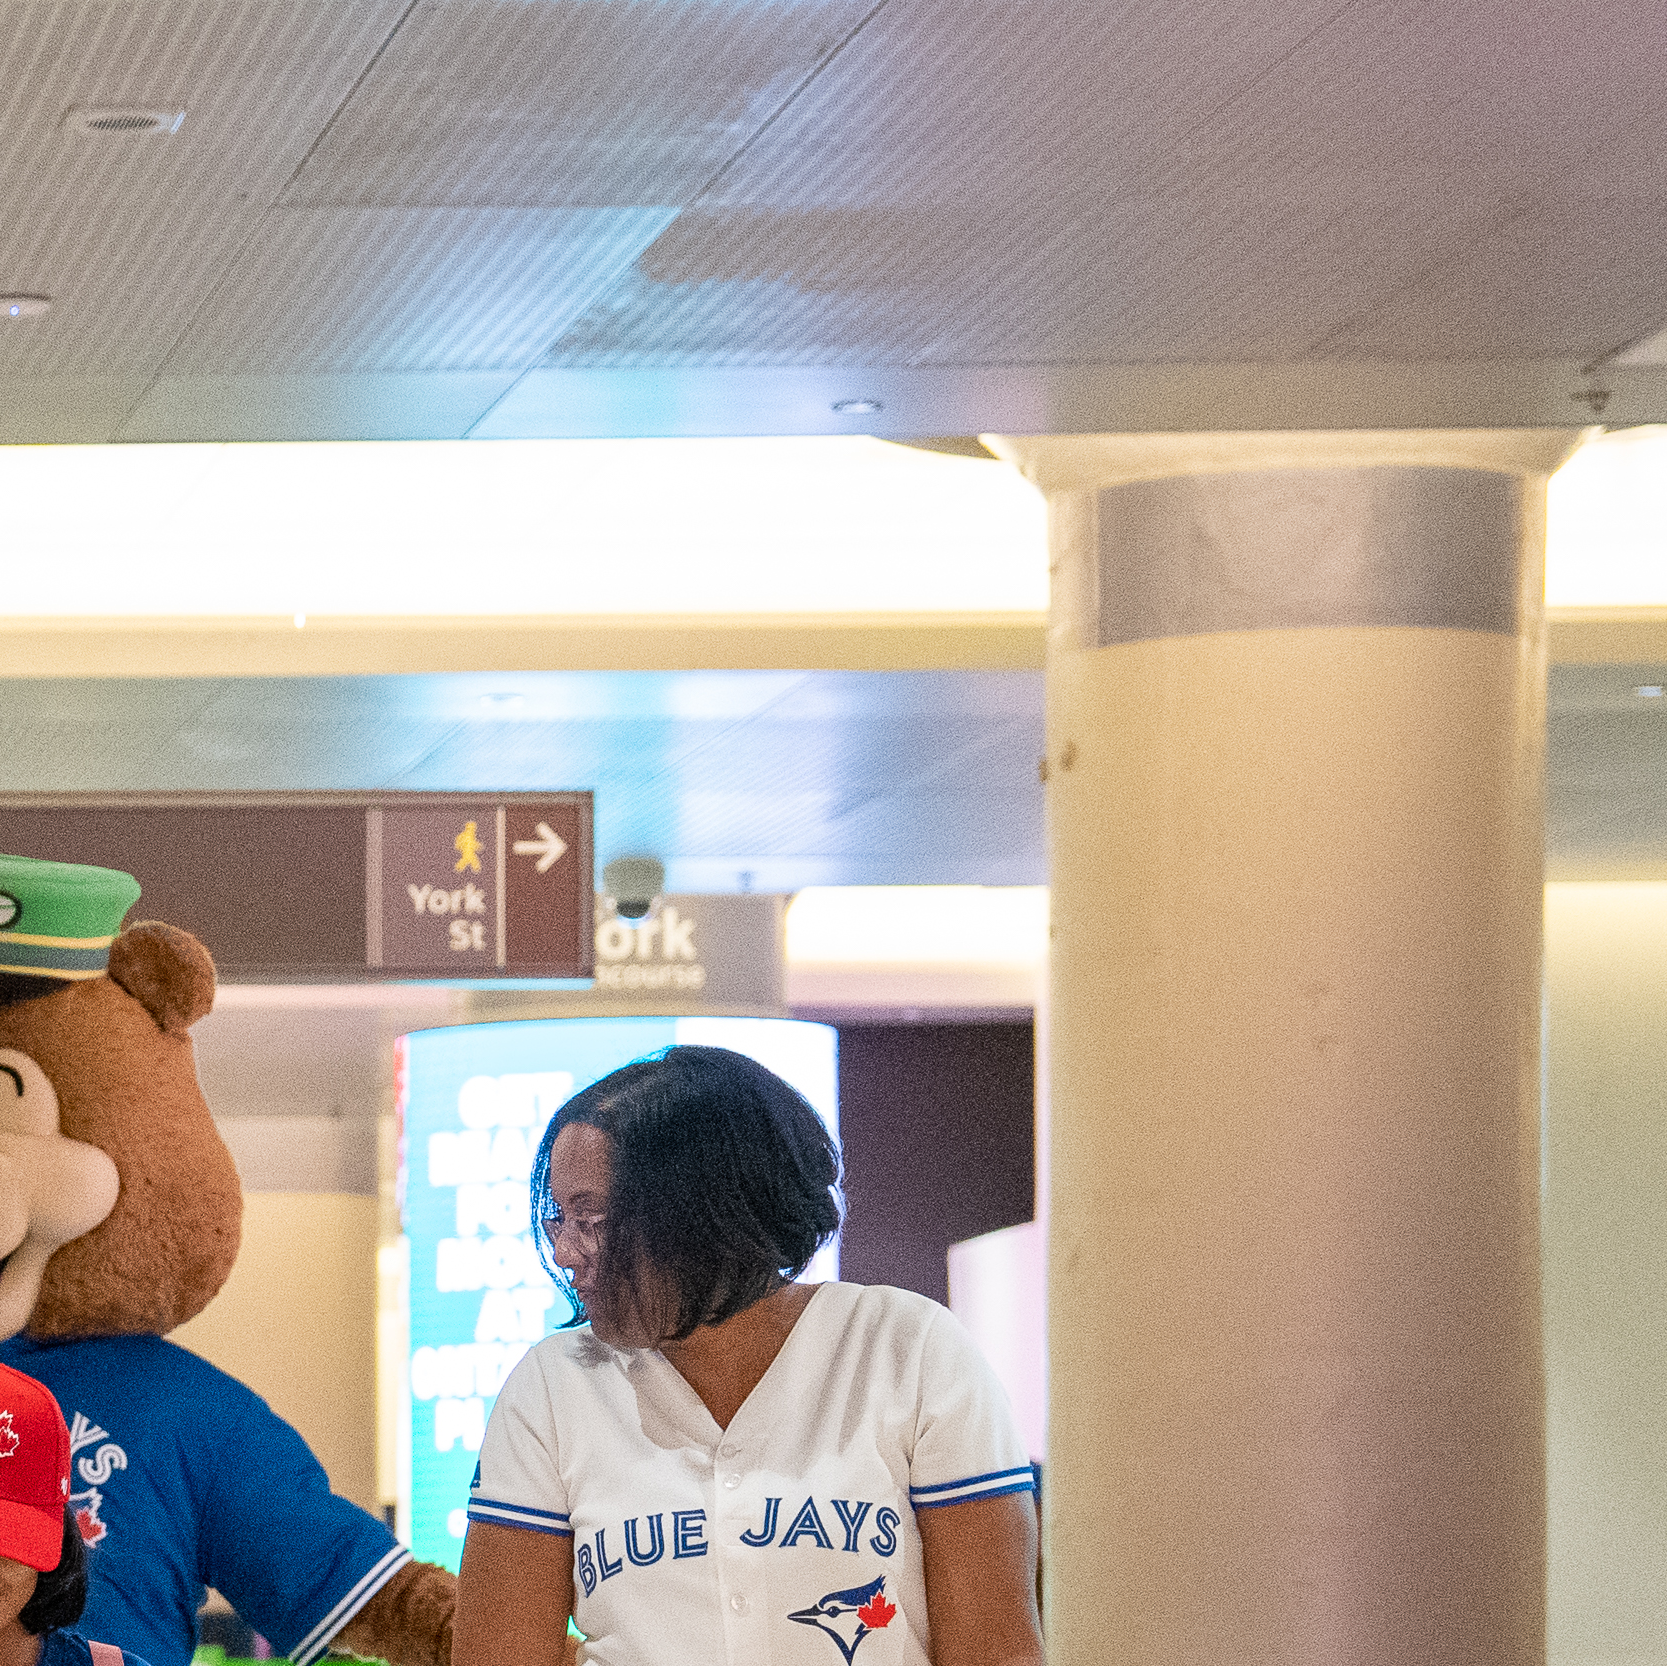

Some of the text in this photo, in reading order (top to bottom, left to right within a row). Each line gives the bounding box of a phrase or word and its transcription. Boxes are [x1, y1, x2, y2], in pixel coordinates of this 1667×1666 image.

[407, 883, 486, 915] York
[448, 920, 486, 951] St
[595, 906, 697, 961] ork
[70, 1411, 128, 1486] YS
[576, 1495, 902, 1599] BLUE JAYS
